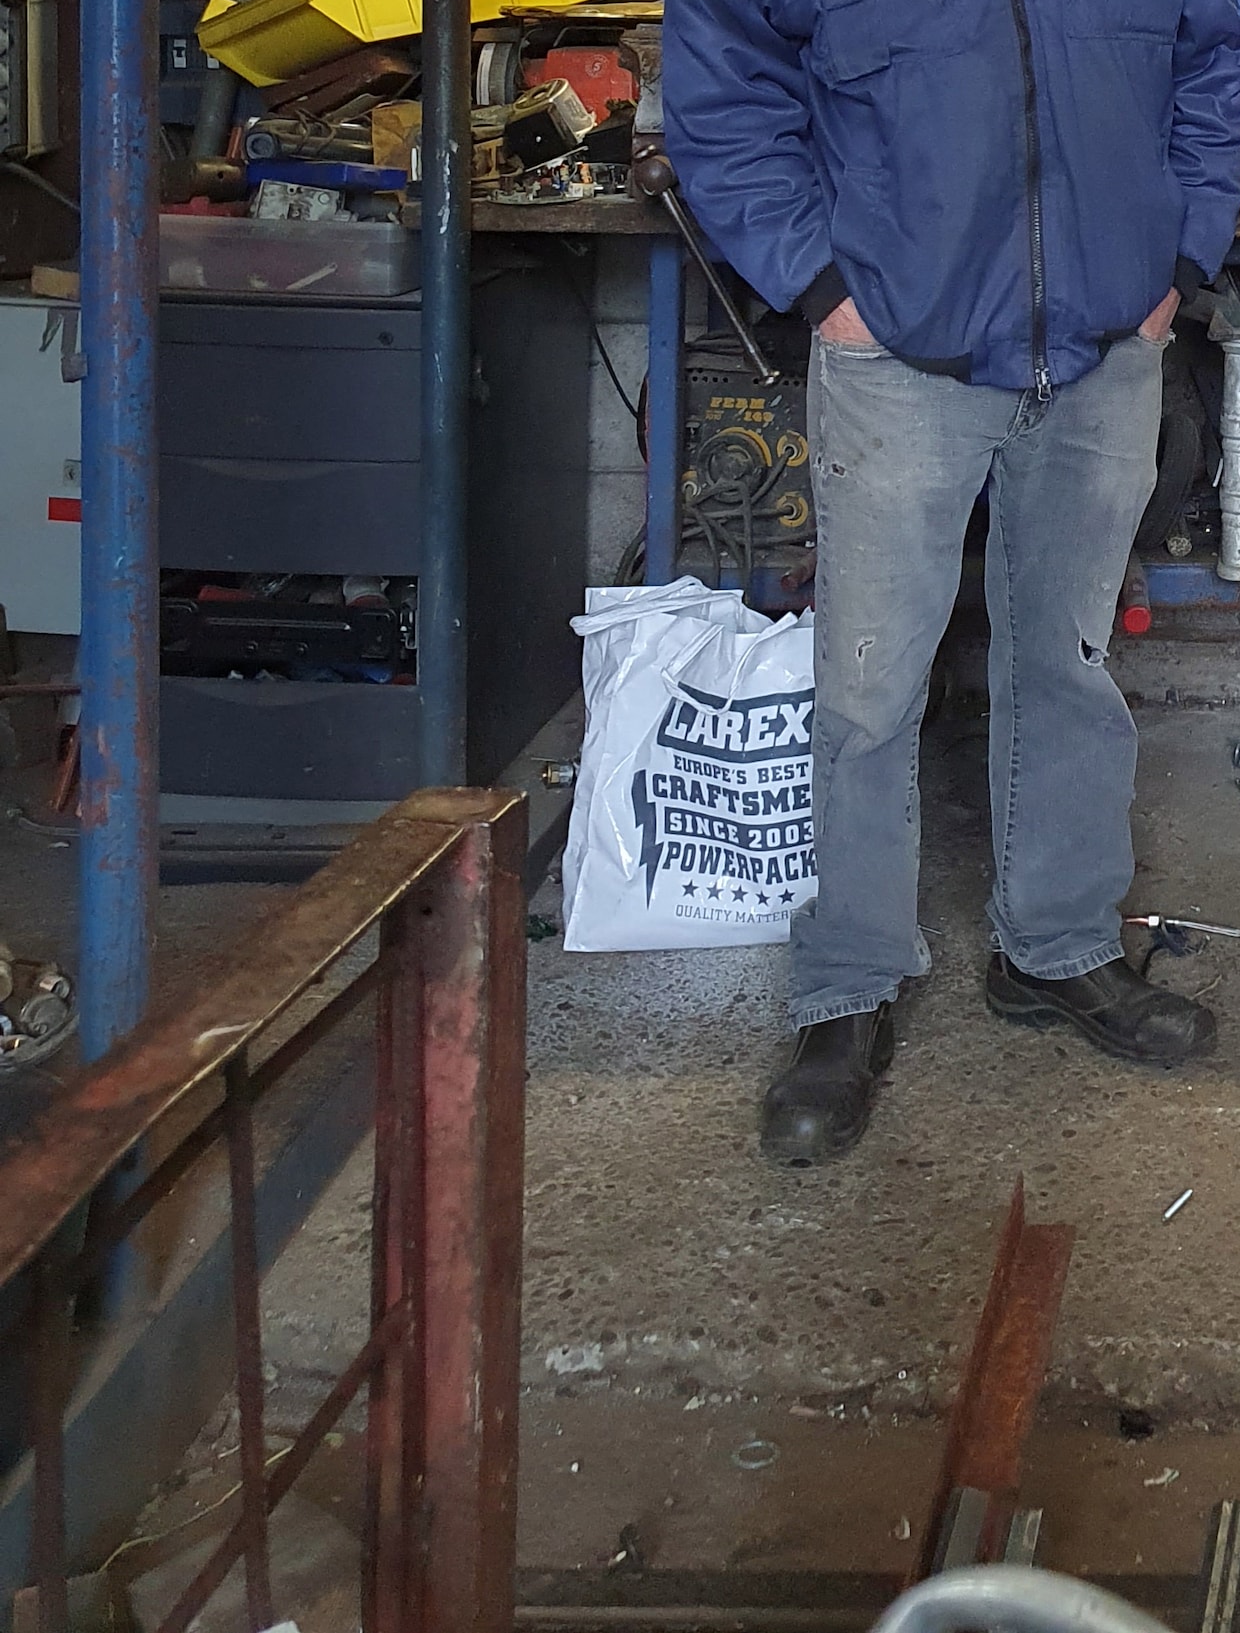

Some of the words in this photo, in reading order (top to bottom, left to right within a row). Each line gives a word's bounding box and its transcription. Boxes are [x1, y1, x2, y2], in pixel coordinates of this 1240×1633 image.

[664, 700, 814, 752] LAREX
[673, 754, 747, 785] EUROPE'S
[757, 761, 809, 784] BEST
[669, 812, 740, 844] SINCE
[748, 820, 813, 848] 2003
[662, 841, 818, 886] POWERPACK
[675, 904, 733, 921] QUALITY
[734, 908, 796, 924] MATTER
